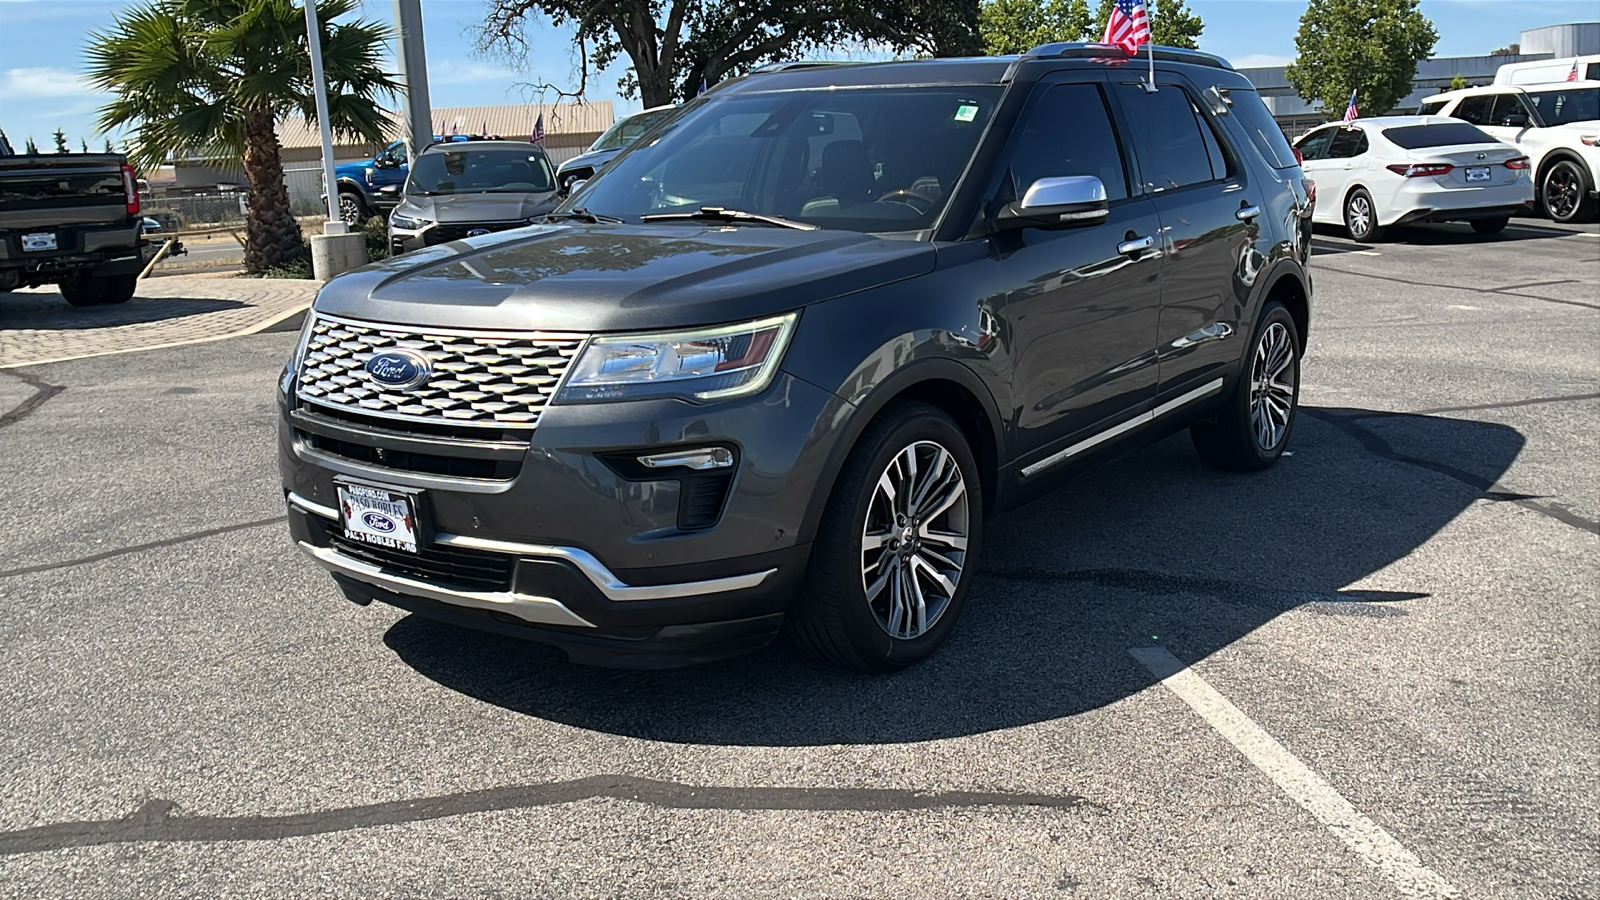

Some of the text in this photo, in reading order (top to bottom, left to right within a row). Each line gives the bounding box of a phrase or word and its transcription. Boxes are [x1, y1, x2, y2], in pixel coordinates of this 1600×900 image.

[373, 357, 406, 378] Ford
[350, 495, 404, 519] PASO ROBLES
[368, 514, 390, 530] Ford
[366, 533, 396, 548] ROBLES
